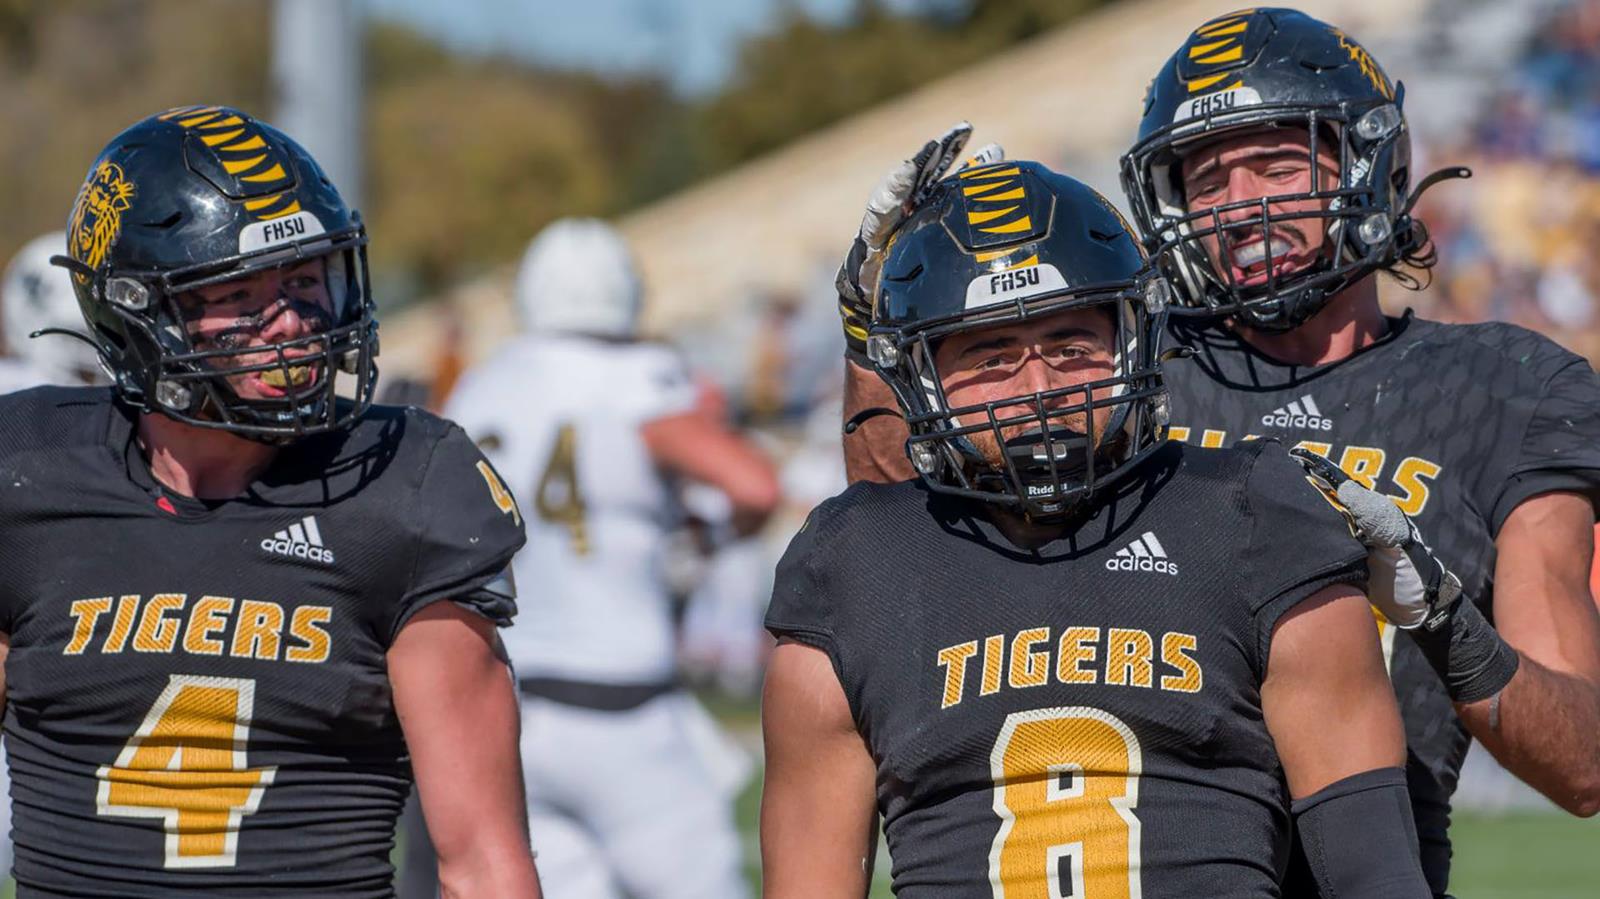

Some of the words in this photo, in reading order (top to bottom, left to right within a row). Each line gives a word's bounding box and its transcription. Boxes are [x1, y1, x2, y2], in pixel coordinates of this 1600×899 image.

[1191, 91, 1235, 117] FHSU
[263, 217, 305, 243] FHSU
[990, 267, 1040, 295] FHSU
[1262, 413, 1333, 431] adidas
[260, 536, 335, 563] adidas
[1105, 554, 1179, 576] adidas
[63, 593, 333, 664] TIGERS
[937, 626, 1203, 710] TIGERS
[96, 674, 279, 868] 4
[988, 705, 1142, 899] 8
